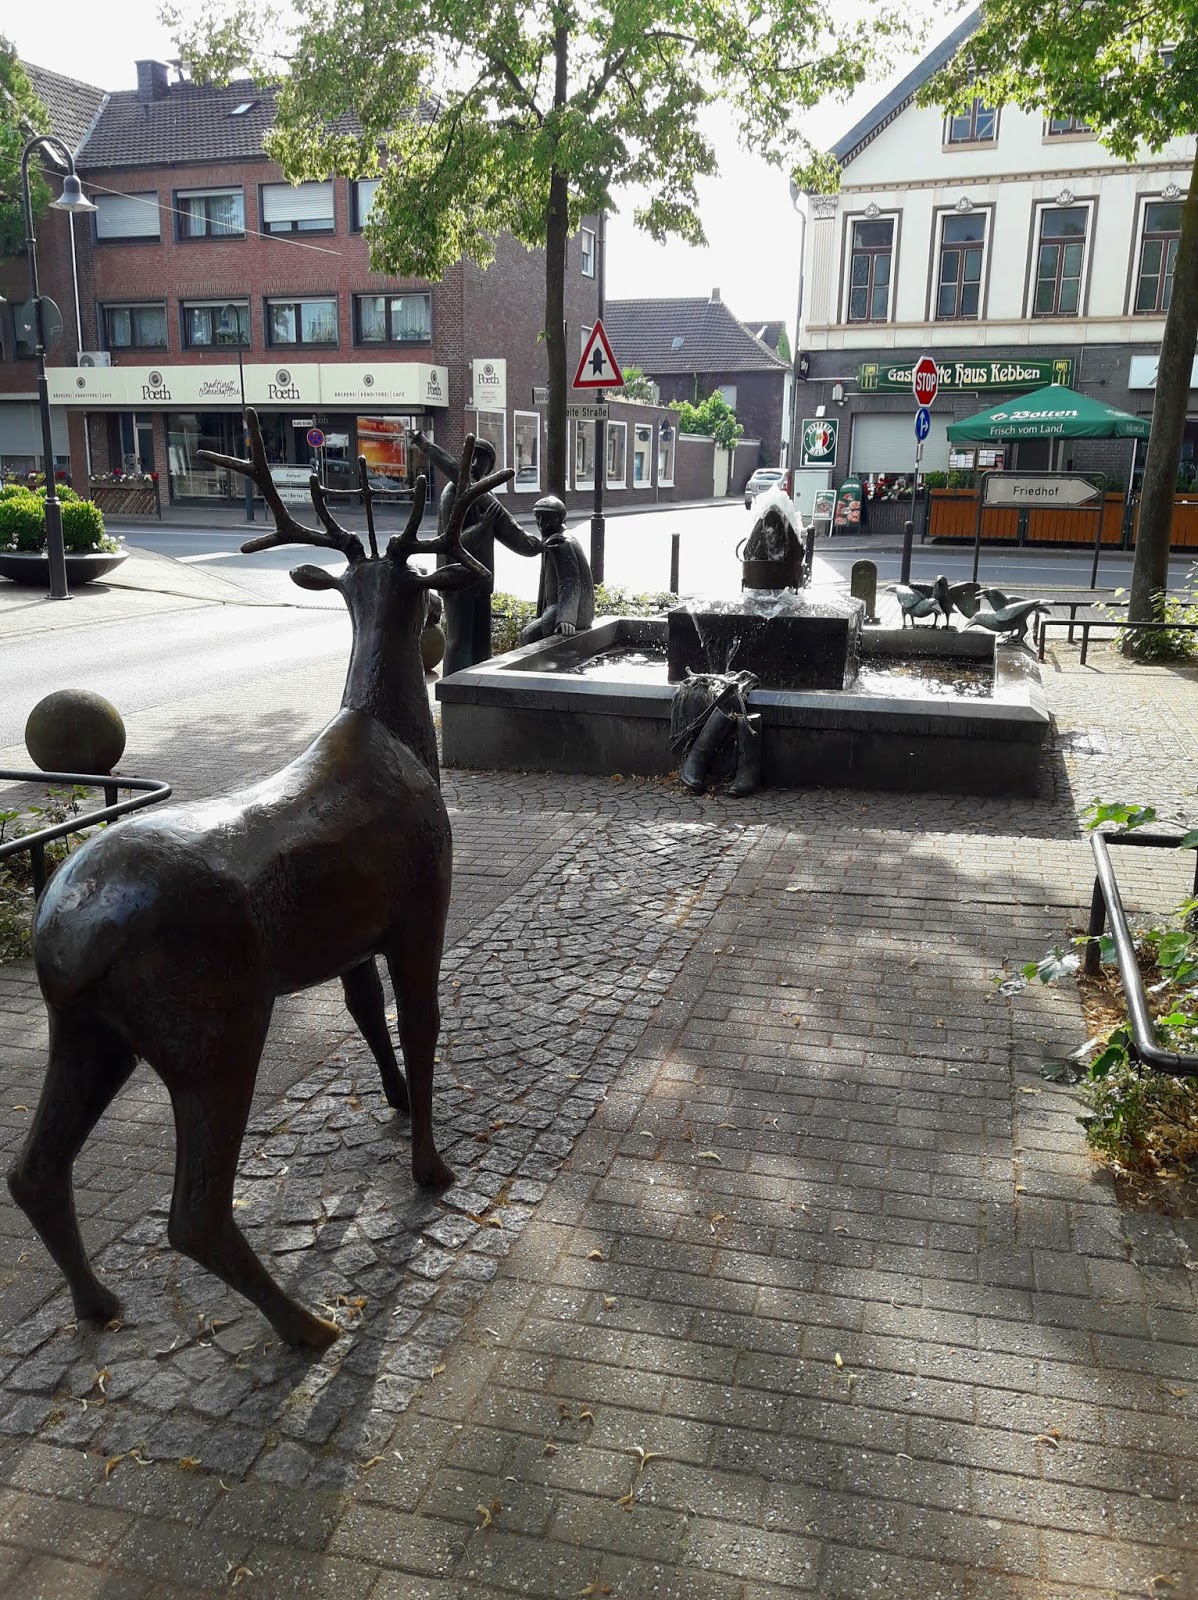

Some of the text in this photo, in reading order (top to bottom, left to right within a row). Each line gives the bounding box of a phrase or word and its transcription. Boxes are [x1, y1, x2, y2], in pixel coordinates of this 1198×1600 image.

[478, 373, 500, 385] Poeth
[916, 372, 937, 392] STOP
[955, 363, 987, 388] Haus
[990, 363, 1040, 383] Kebben
[141, 384, 172, 400] Poeth
[267, 382, 301, 400] Poeth
[427, 381, 442, 396] Poeth
[582, 407, 607, 417] Straße
[990, 423, 1065, 436] Frisch vom Land.
[1013, 485, 1059, 496] Friedhof
